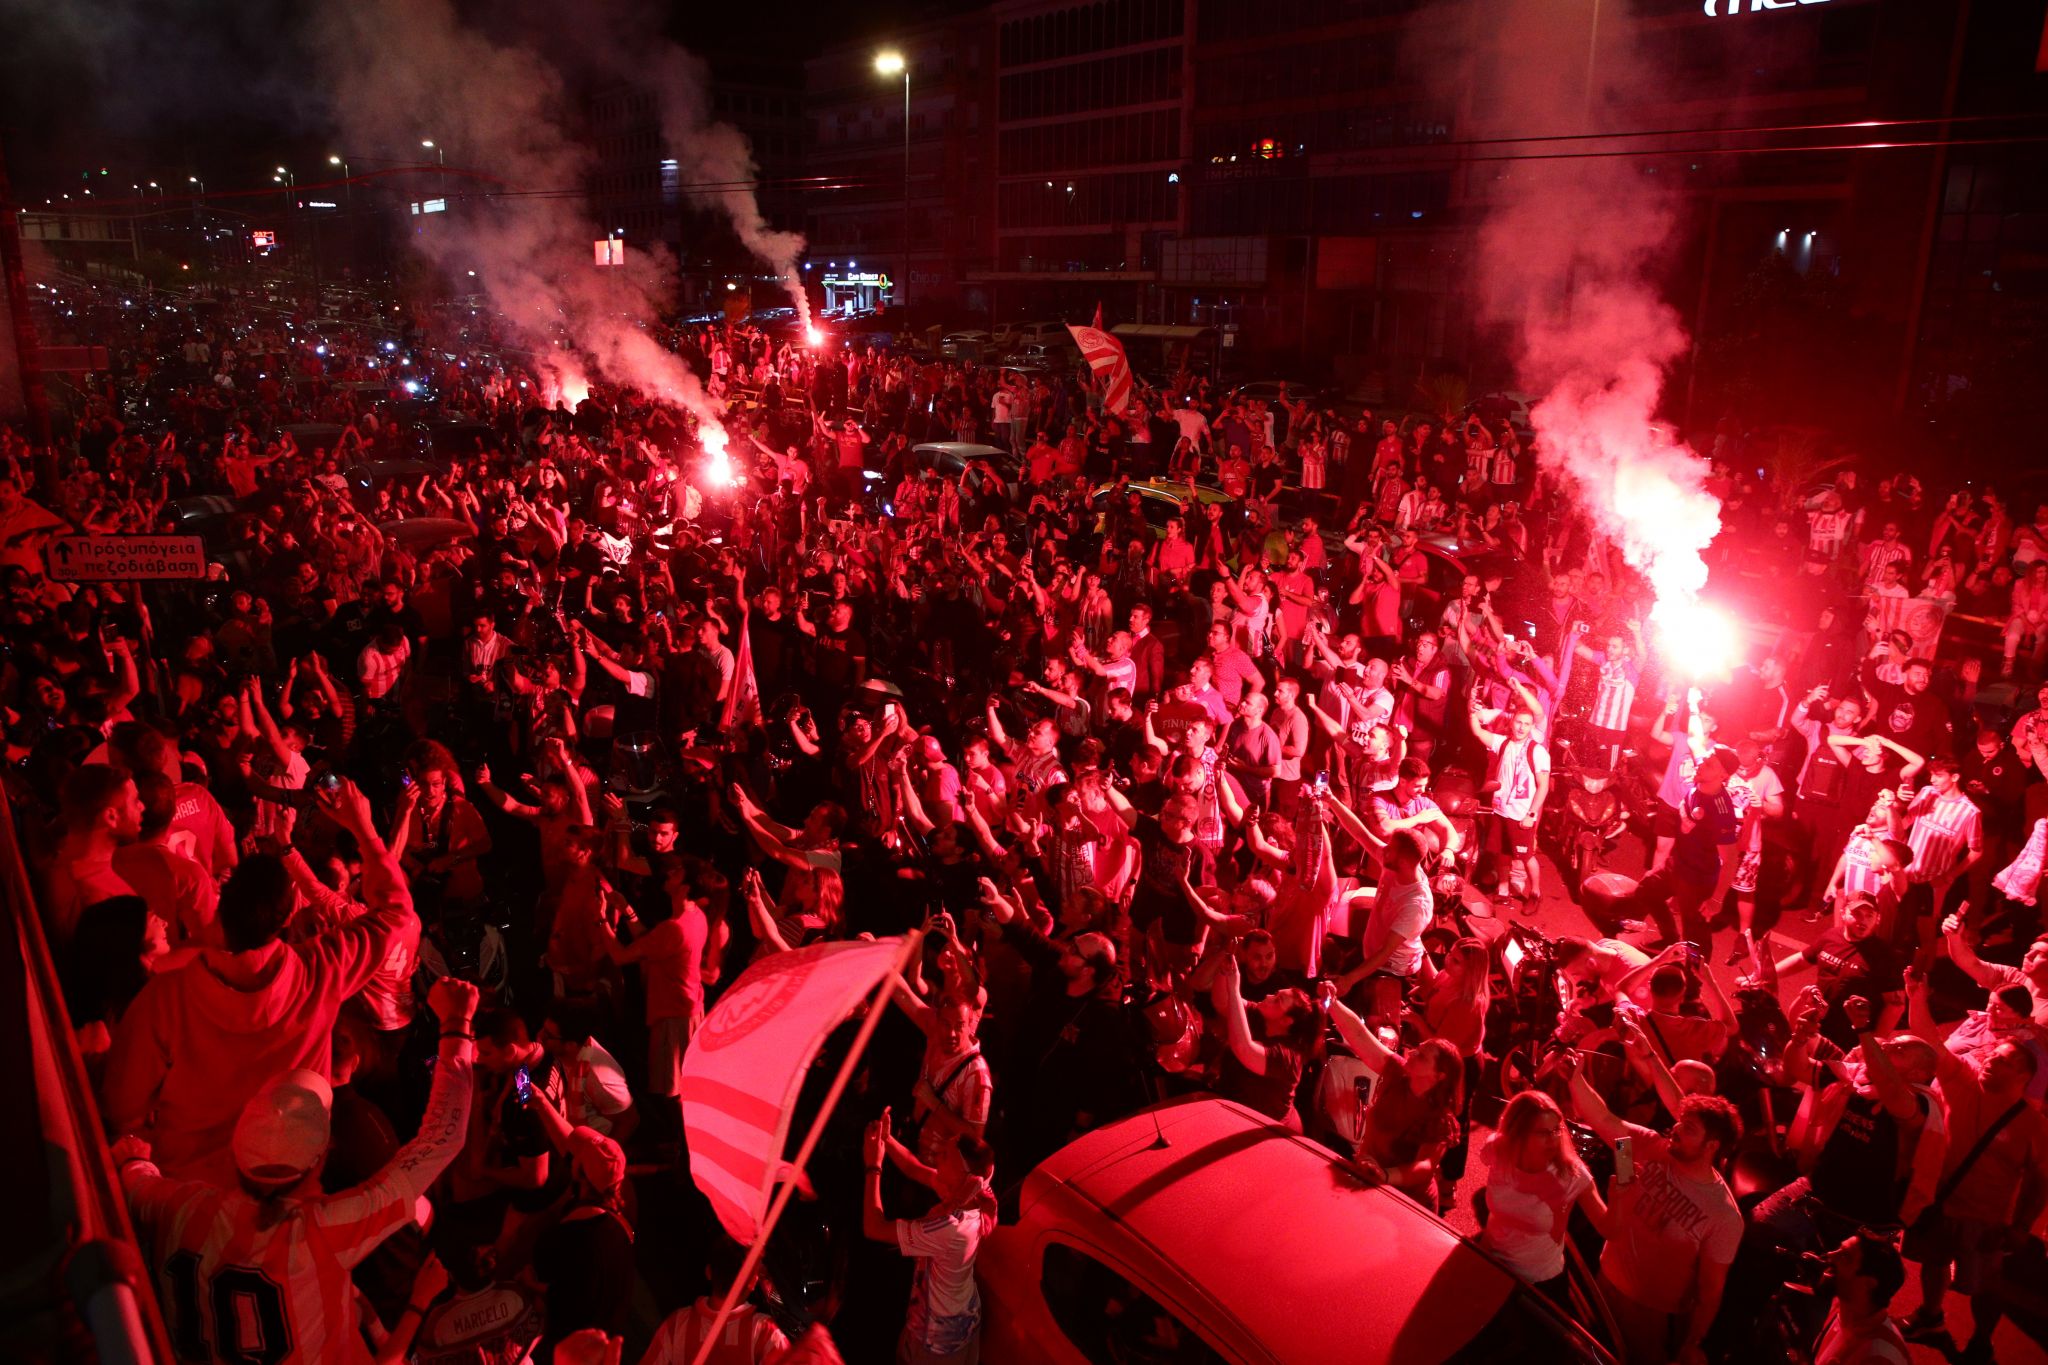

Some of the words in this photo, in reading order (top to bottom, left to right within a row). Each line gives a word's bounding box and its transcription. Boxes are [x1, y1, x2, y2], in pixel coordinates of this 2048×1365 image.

[84, 558, 199, 576] πεζοδιάβαση
[1639, 1160, 1709, 1232] SUPERDRY
[452, 1302, 509, 1335] MARCELO
